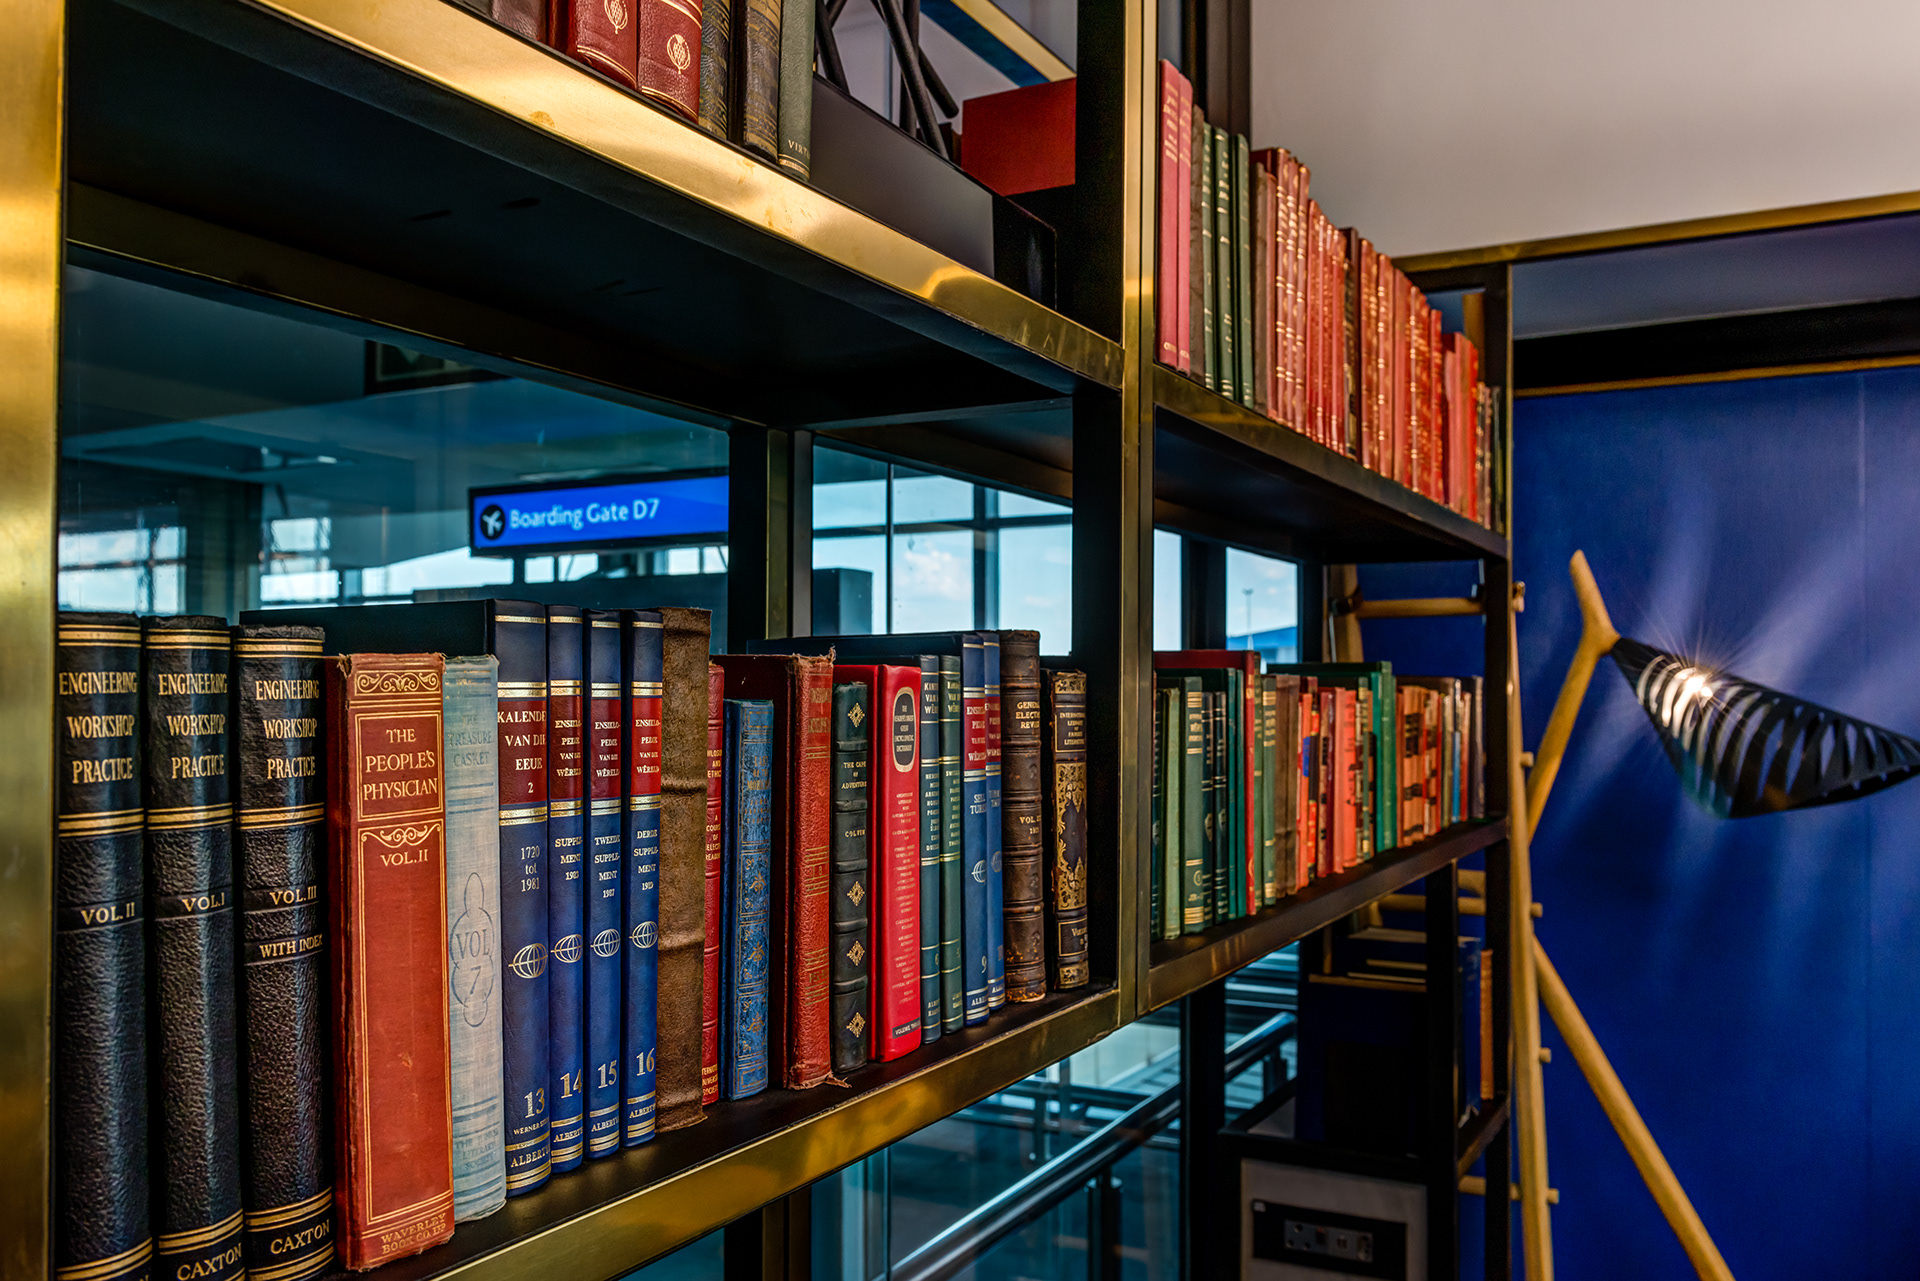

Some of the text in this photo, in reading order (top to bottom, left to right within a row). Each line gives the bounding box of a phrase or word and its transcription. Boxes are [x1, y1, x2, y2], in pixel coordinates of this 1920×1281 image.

[510, 498, 660, 530] Boarding Gate D7
[58, 672, 137, 695] ENGINEERING
[158, 674, 228, 695] ENGINEERING
[255, 680, 320, 701] ENGINEERING
[67, 715, 135, 738] WORKSHOP
[166, 714, 226, 736] WORKSHOP
[262, 718, 318, 739] WORKSHOP
[386, 728, 416, 744] THE
[504, 735, 530, 747] VAN
[171, 754, 225, 780] PRACTICE
[366, 750, 435, 772] PEOPLE'S
[454, 752, 490, 767] CASKET
[515, 758, 543, 770] EEUE
[560, 752, 574, 760] VAN
[599, 754, 611, 762] VAN
[72, 758, 133, 784] PRACTICE
[266, 756, 316, 780] PRACTICE
[364, 778, 438, 800] PHYSICIAN
[528, 782, 534, 794] 2
[560, 854, 581, 864] MENT
[638, 864, 656, 874] MENT
[520, 877, 540, 892] 1981
[599, 870, 618, 881] MENT
[259, 940, 296, 958] WITH
[456, 929, 490, 960] VOL
[982, 956, 987, 974] 9
[470, 966, 482, 995] 7
[636, 1048, 655, 1076] 16
[560, 1069, 582, 1099] 14
[598, 1059, 617, 1089] 15
[524, 1087, 545, 1119] 13
[270, 1218, 330, 1254] CAXTON
[381, 1212, 446, 1244] WAVERLEY
[382, 1236, 414, 1254] BOOK
[177, 1242, 242, 1281] CAXTON
